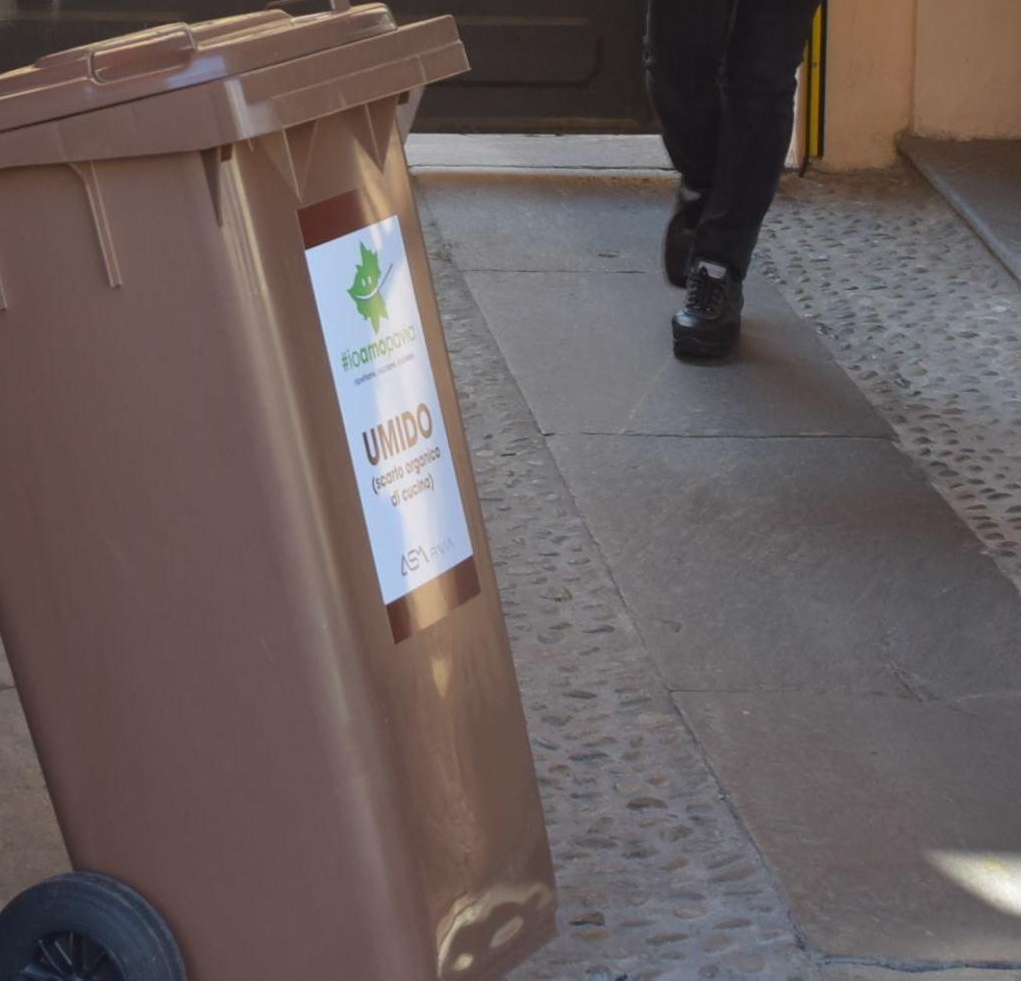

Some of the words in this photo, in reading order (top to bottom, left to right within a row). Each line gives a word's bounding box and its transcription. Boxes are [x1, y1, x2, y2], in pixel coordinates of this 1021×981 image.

[340, 323, 416, 372] #ioamopavia
[361, 402, 433, 466] UMIDO
[372, 465, 405, 496] (scarto
[405, 446, 441, 474] organico
[390, 490, 401, 508] di
[402, 473, 435, 502] cucina)
